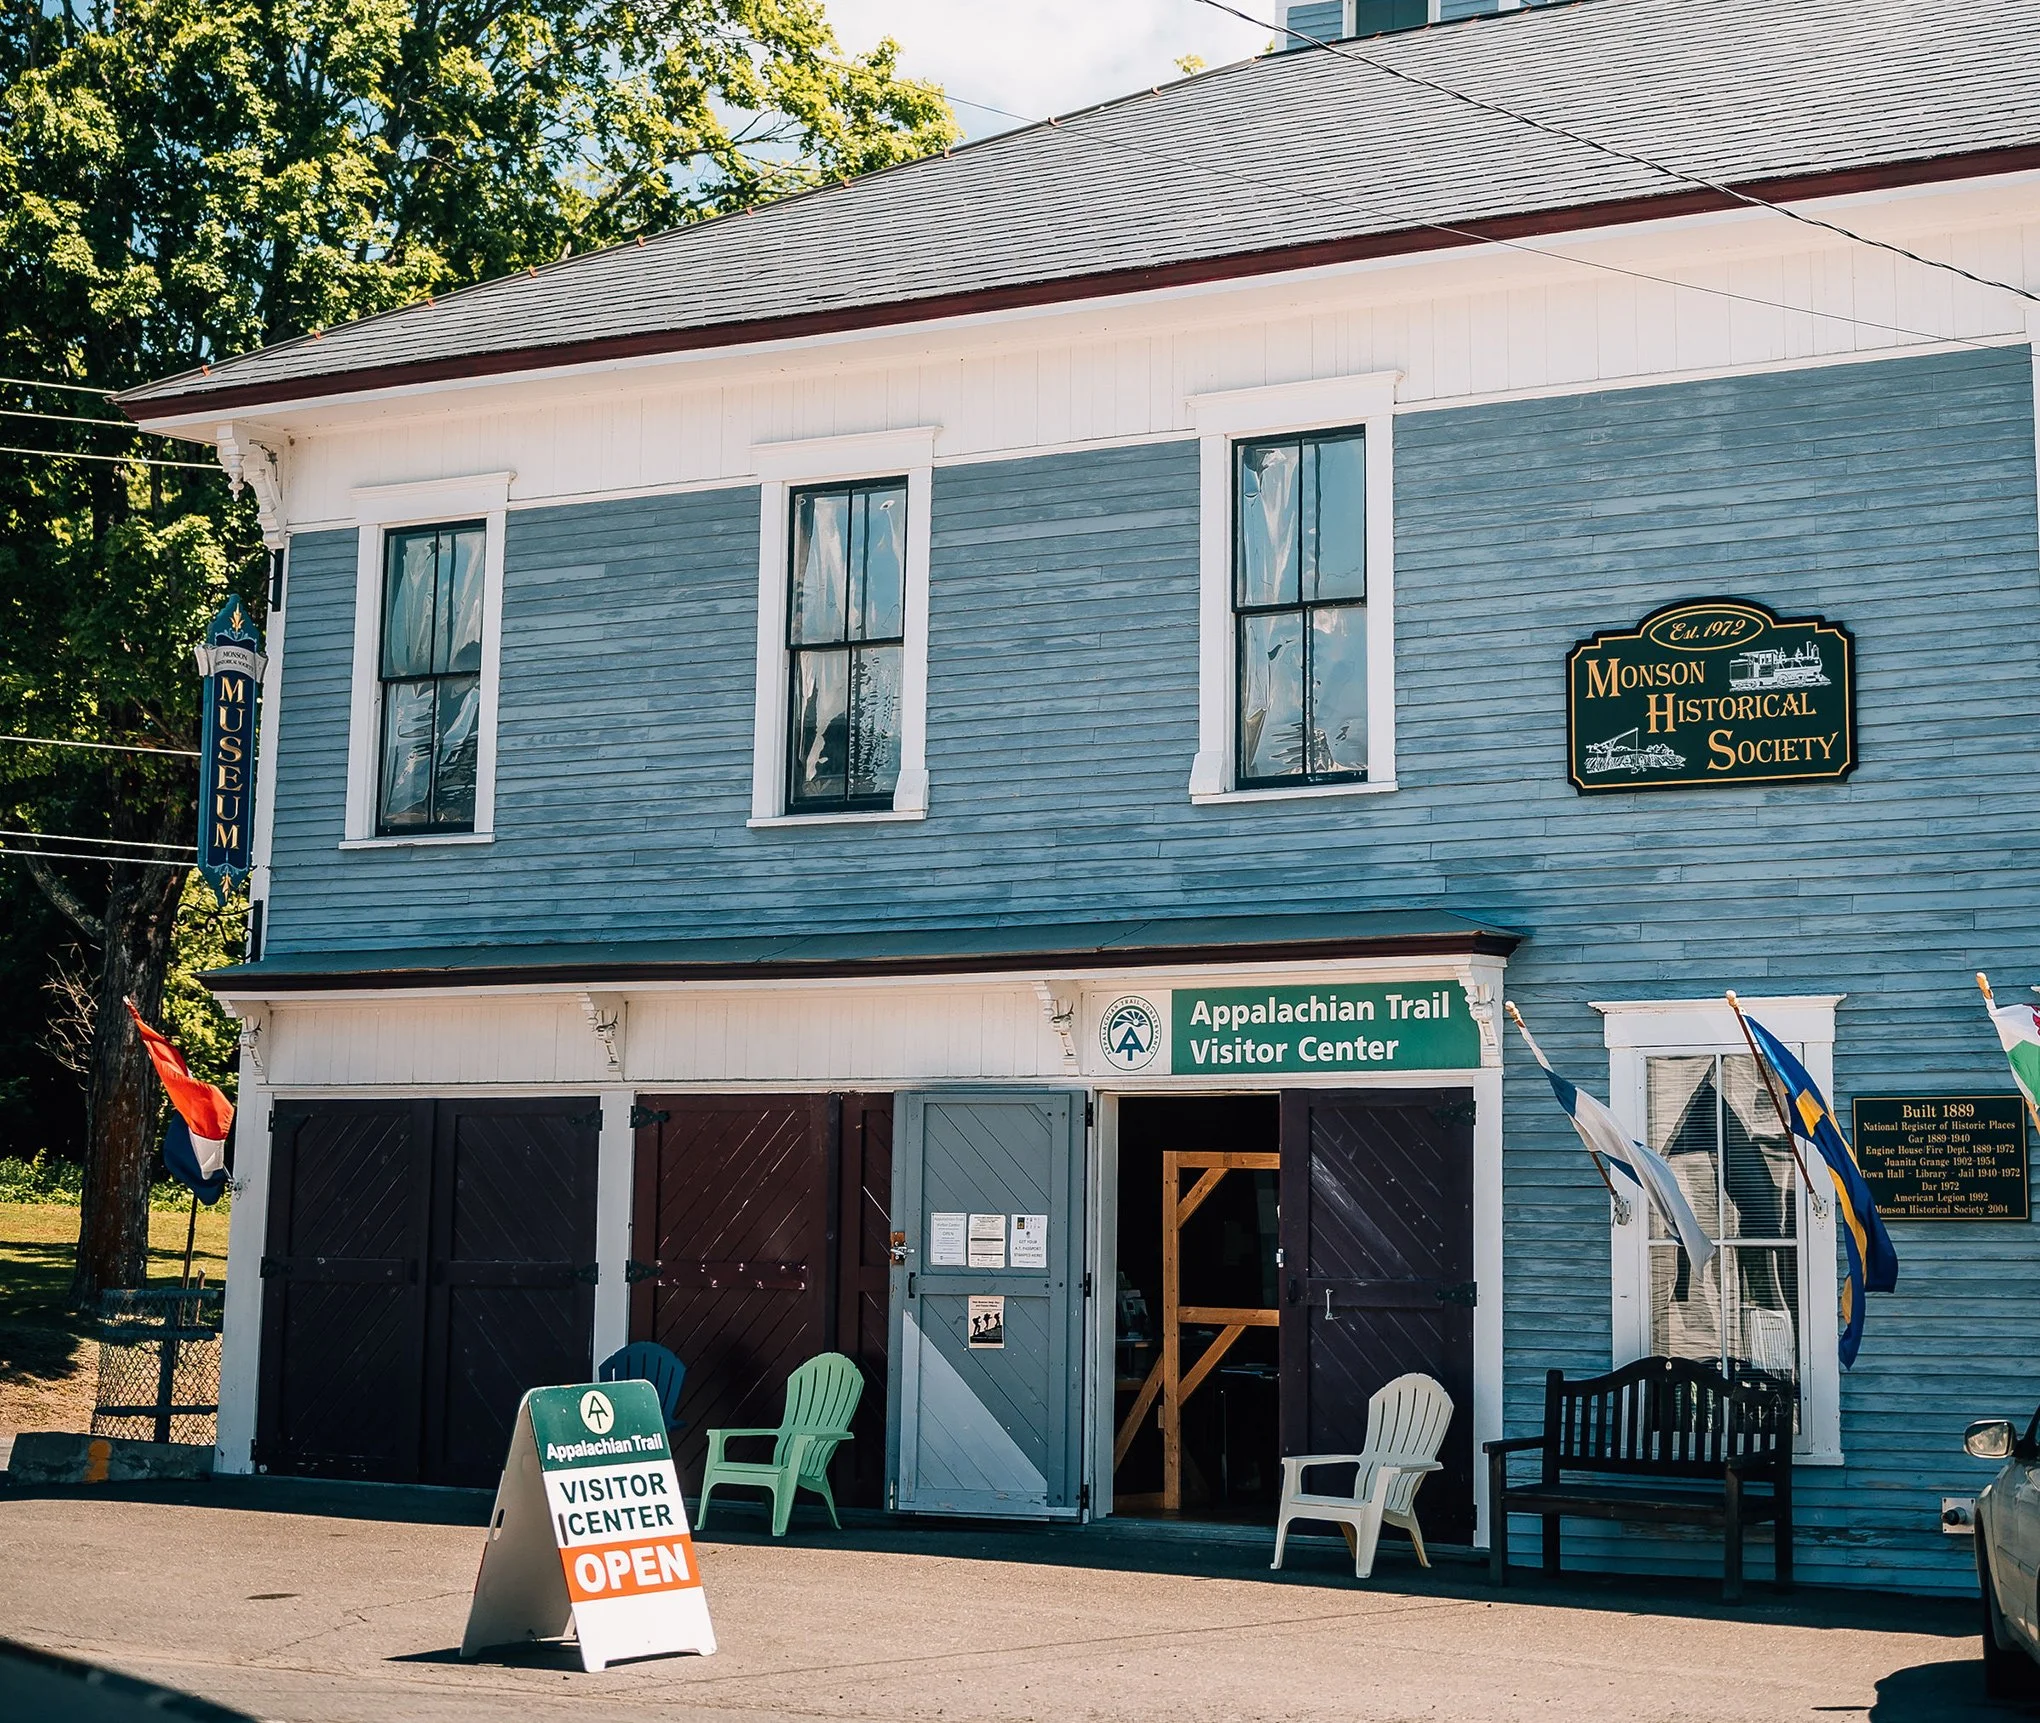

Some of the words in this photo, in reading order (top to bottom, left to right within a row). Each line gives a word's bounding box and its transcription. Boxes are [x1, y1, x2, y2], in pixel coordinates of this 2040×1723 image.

[1669, 622, 1699, 641] Est.
[1703, 619, 1747, 638] 1972
[1585, 658, 1705, 699] MONSON
[1645, 692, 1817, 734] HISTORICAL
[213, 676, 245, 850] MUSEUM
[1707, 729, 1839, 772] SOCIETY
[1189, 995, 1375, 1032] Appalachian
[1385, 991, 1450, 1020] Trail
[1189, 1037, 1288, 1065] Visitor
[1298, 1036, 1399, 1064] Center
[1902, 1104, 1936, 1119] Built
[1942, 1103, 1975, 1118] 1889
[1863, 1122, 1898, 1132] National
[1901, 1121, 1936, 1132] Register
[1939, 1121, 1948, 1130] of
[1951, 1120, 1986, 1130] Historic
[1989, 1120, 2016, 1130] Places
[1908, 1134, 1924, 1144] Gar
[1927, 1133, 1971, 1143] 1889-1940
[1865, 1145, 1895, 1156] Engine
[1947, 1144, 1969, 1155] Dept.
[1972, 1144, 2015, 1154] 1889-1972
[1884, 1157, 1917, 1167] Juanita
[1919, 1157, 1950, 1168] Grange
[1953, 1157, 1996, 1166] 1902-1954
[1861, 1169, 1884, 1179] Town
[1887, 1169, 1905, 1178] Hall
[1915, 1169, 1947, 1180] Library
[1958, 1168, 1975, 1178] Jail
[1978, 1168, 2021, 1177] 1940-1972
[1922, 1182, 1937, 1191] Dar
[1940, 1181, 1960, 1191] 1972
[1894, 1193, 1934, 1202] American
[1937, 1192, 1966, 1203] Legion
[1969, 1192, 1989, 1202] 1992
[1909, 1204, 1951, 1214] Historical
[1953, 1204, 1985, 1215] Society
[1988, 1203, 2009, 1214] 2004
[546, 1437, 633, 1463] Appalachian
[634, 1433, 664, 1452] Trail
[560, 1472, 668, 1504] VISITOR
[568, 1504, 674, 1536] CENTER
[574, 1543, 691, 1594] OPEN
